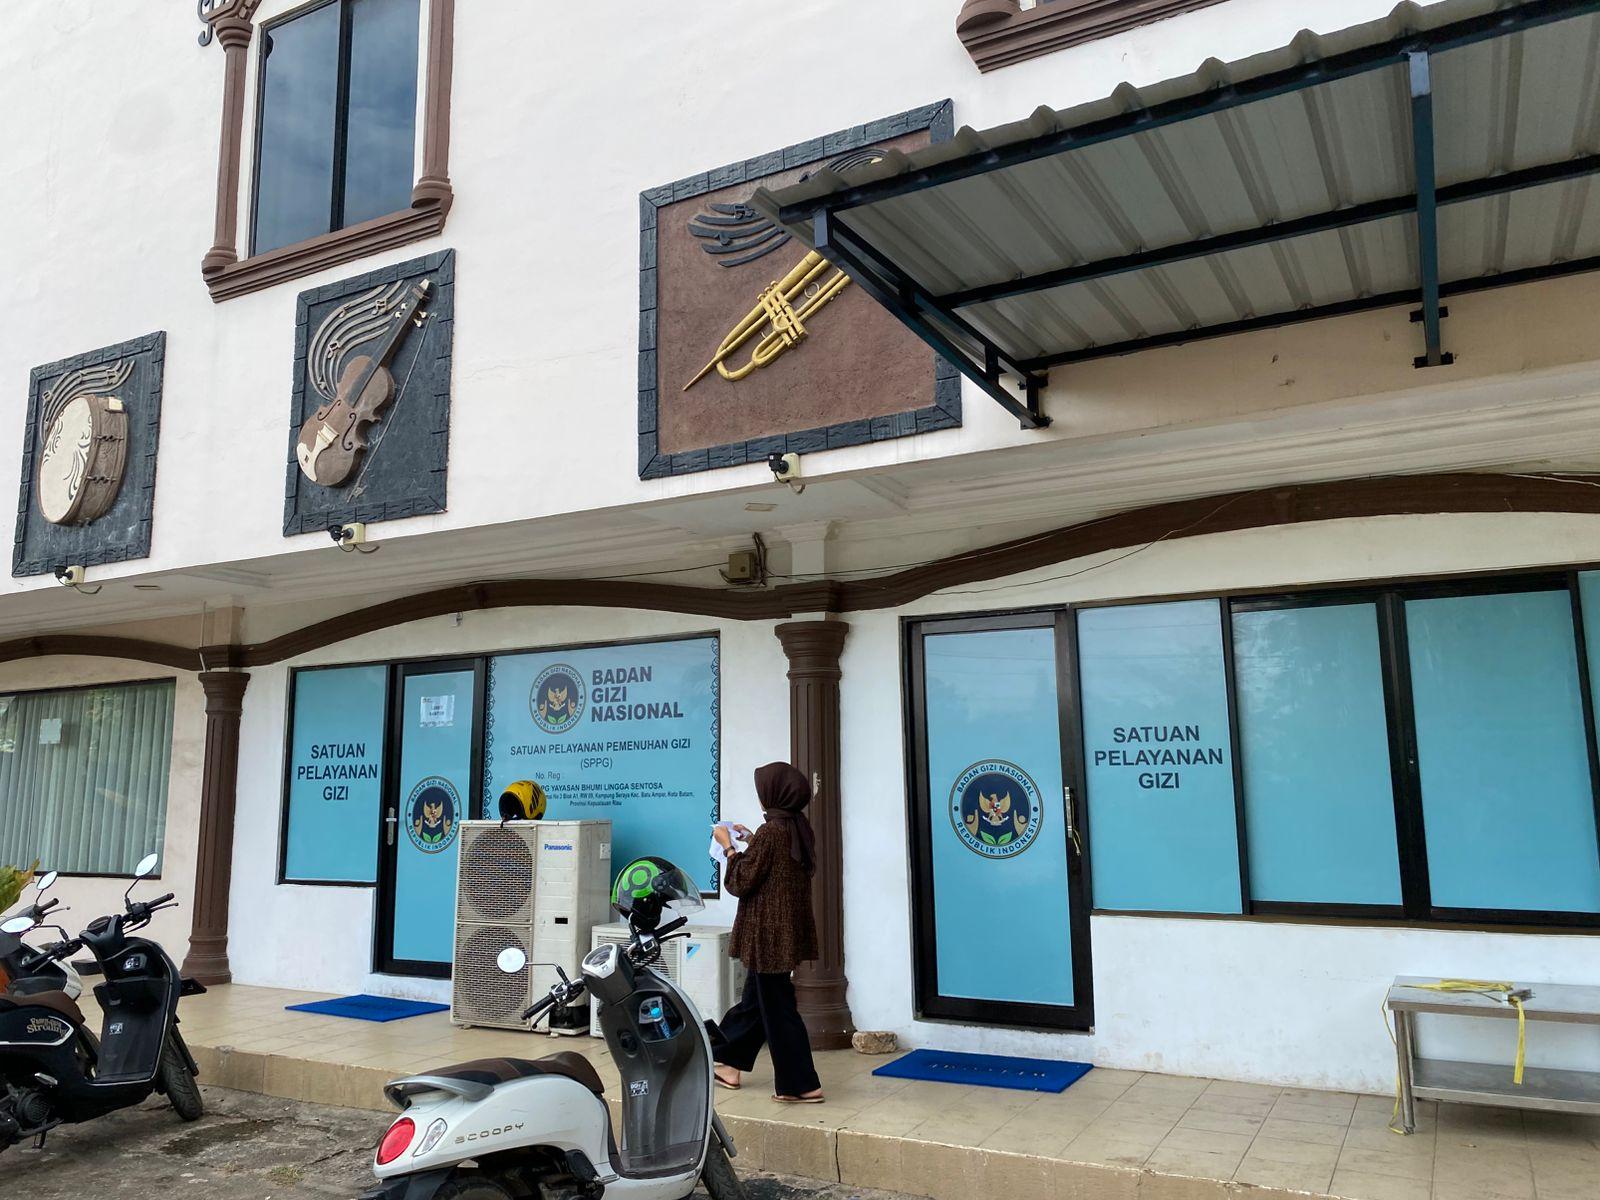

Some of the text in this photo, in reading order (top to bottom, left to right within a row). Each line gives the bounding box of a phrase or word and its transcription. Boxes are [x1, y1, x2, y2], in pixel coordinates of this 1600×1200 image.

[592, 666, 652, 686] BADAN
[591, 686, 627, 704] GIZI
[591, 702, 684, 722] NASIONAL
[1113, 725, 1200, 743] SATUAN
[310, 743, 366, 759] SATUAN
[510, 738, 691, 756] SATUAN PELAYANAN PEMENUHAN GIZI
[580, 757, 613, 769] (SPPG)
[1094, 748, 1223, 766] PELAYANAN
[297, 764, 378, 780] PELAYANAN
[956, 764, 1034, 797] BADAN GIZI NASIONAL
[1138, 772, 1180, 789] GIZI
[322, 786, 349, 801] GIZI
[551, 784, 580, 792] YAYASAN
[581, 783, 603, 791] BHUMI
[604, 783, 630, 791] LINGGA
[630, 782, 663, 790] SENTOSA
[595, 792, 614, 800] Kampung
[956, 817, 1038, 854] REPUBLIK INDONESIA
[455, 1122, 524, 1144] SCOOPY
